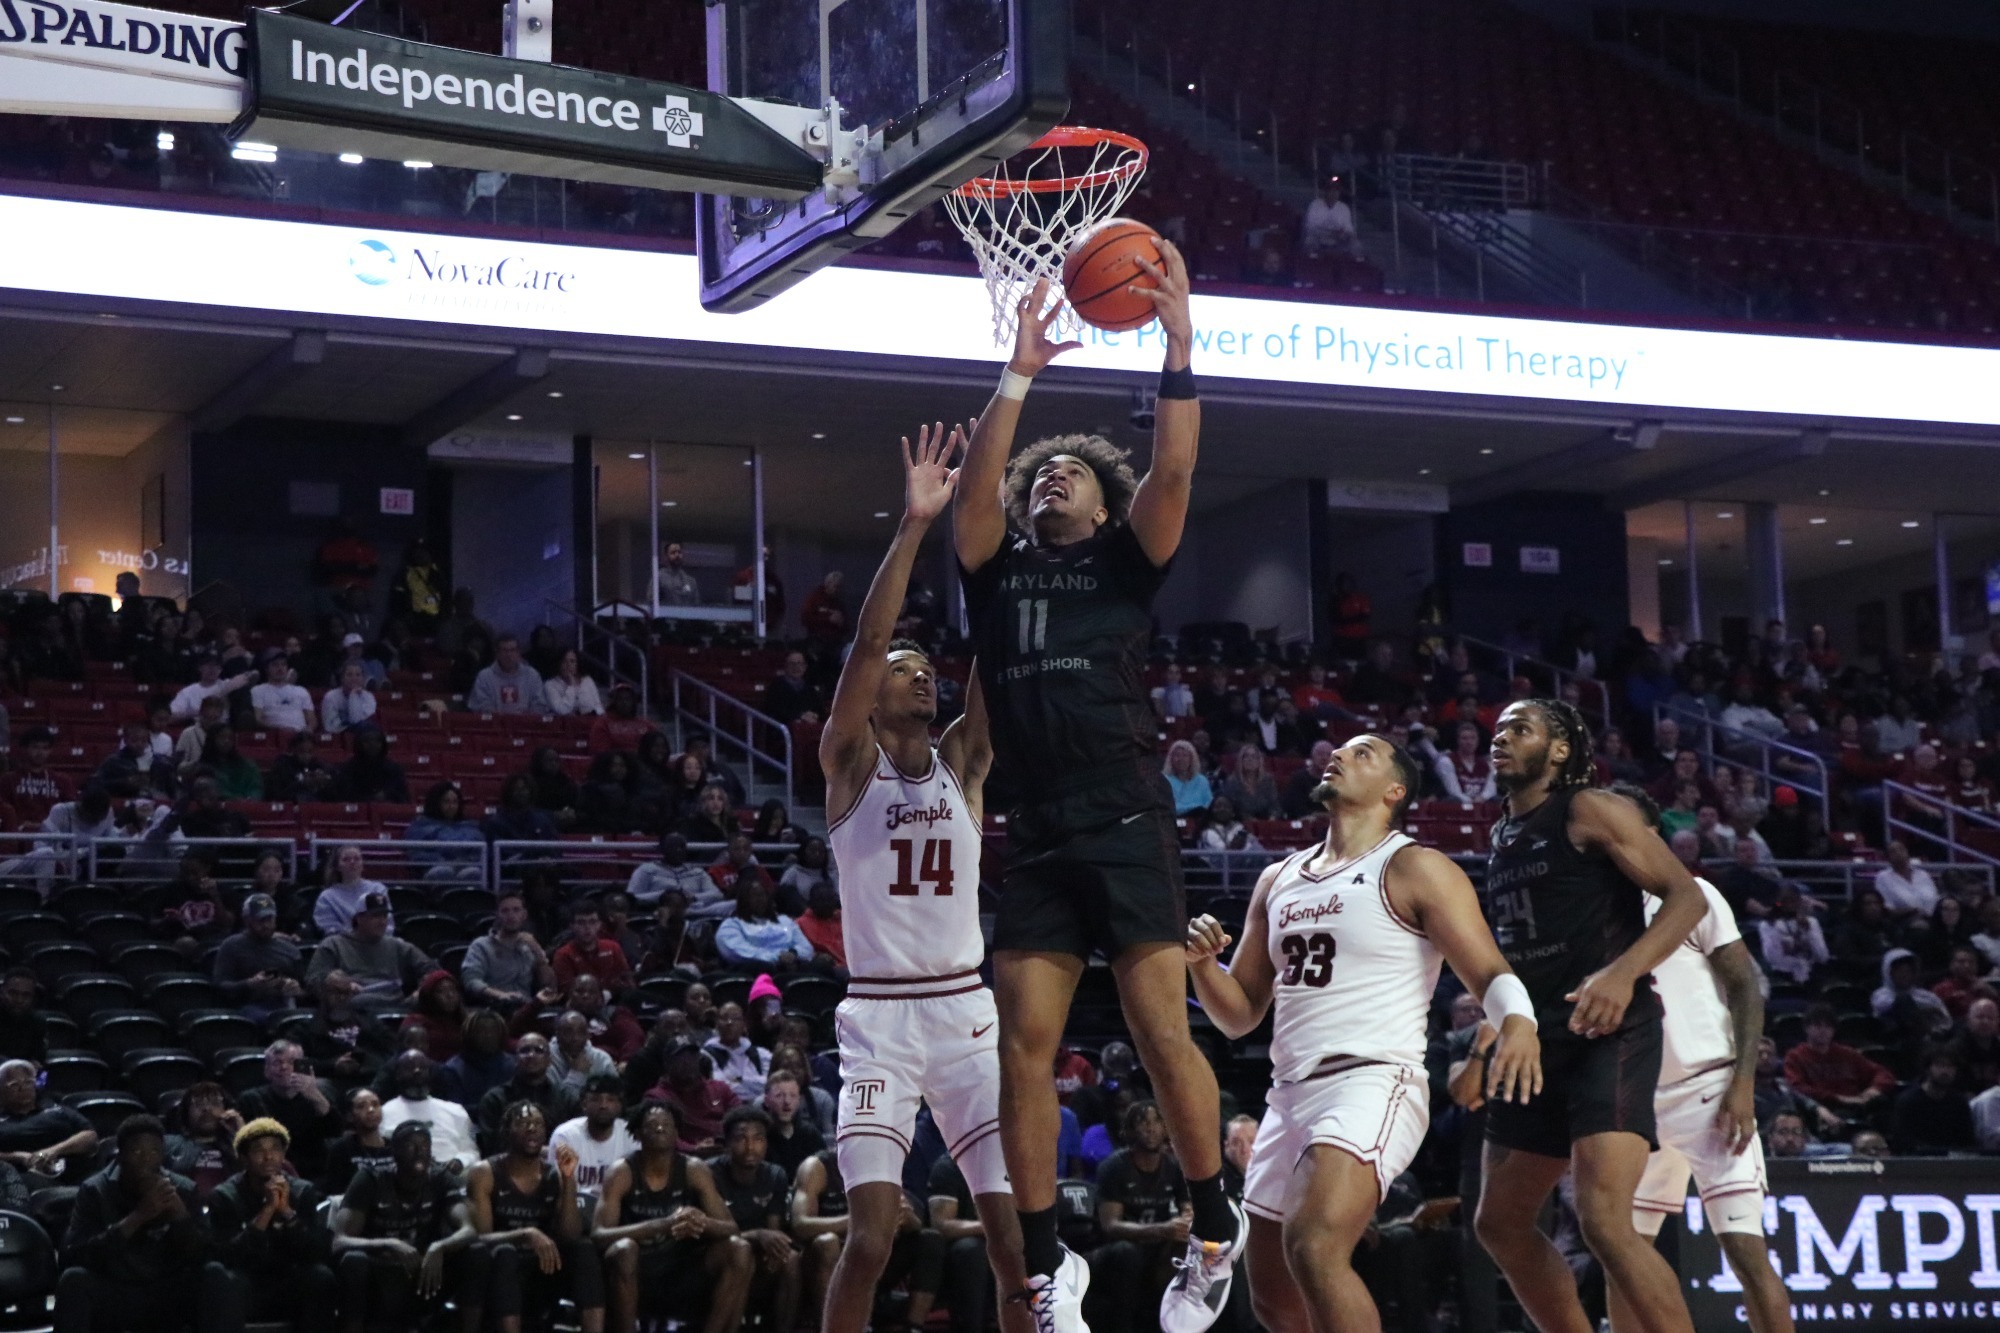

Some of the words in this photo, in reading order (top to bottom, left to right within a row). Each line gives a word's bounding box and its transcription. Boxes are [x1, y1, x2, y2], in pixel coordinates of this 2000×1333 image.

[0, 0, 247, 79] SPALDING
[292, 39, 640, 131] Independence
[408, 248, 575, 293] NovaCare
[1137, 317, 1253, 356] Pwer
[1264, 323, 1301, 359] of
[1315, 325, 1463, 374] Physical
[1476, 337, 1627, 390] Therapy
[999, 573, 1098, 592] ARYLAND
[1017, 598, 1049, 655] 11
[1041, 657, 1092, 672] SHORE
[886, 798, 953, 830] Temple
[889, 838, 954, 896] 14
[1279, 893, 1344, 928] Temple
[1281, 932, 1336, 988] 33
[1735, 1302, 1873, 1321] CINARY
